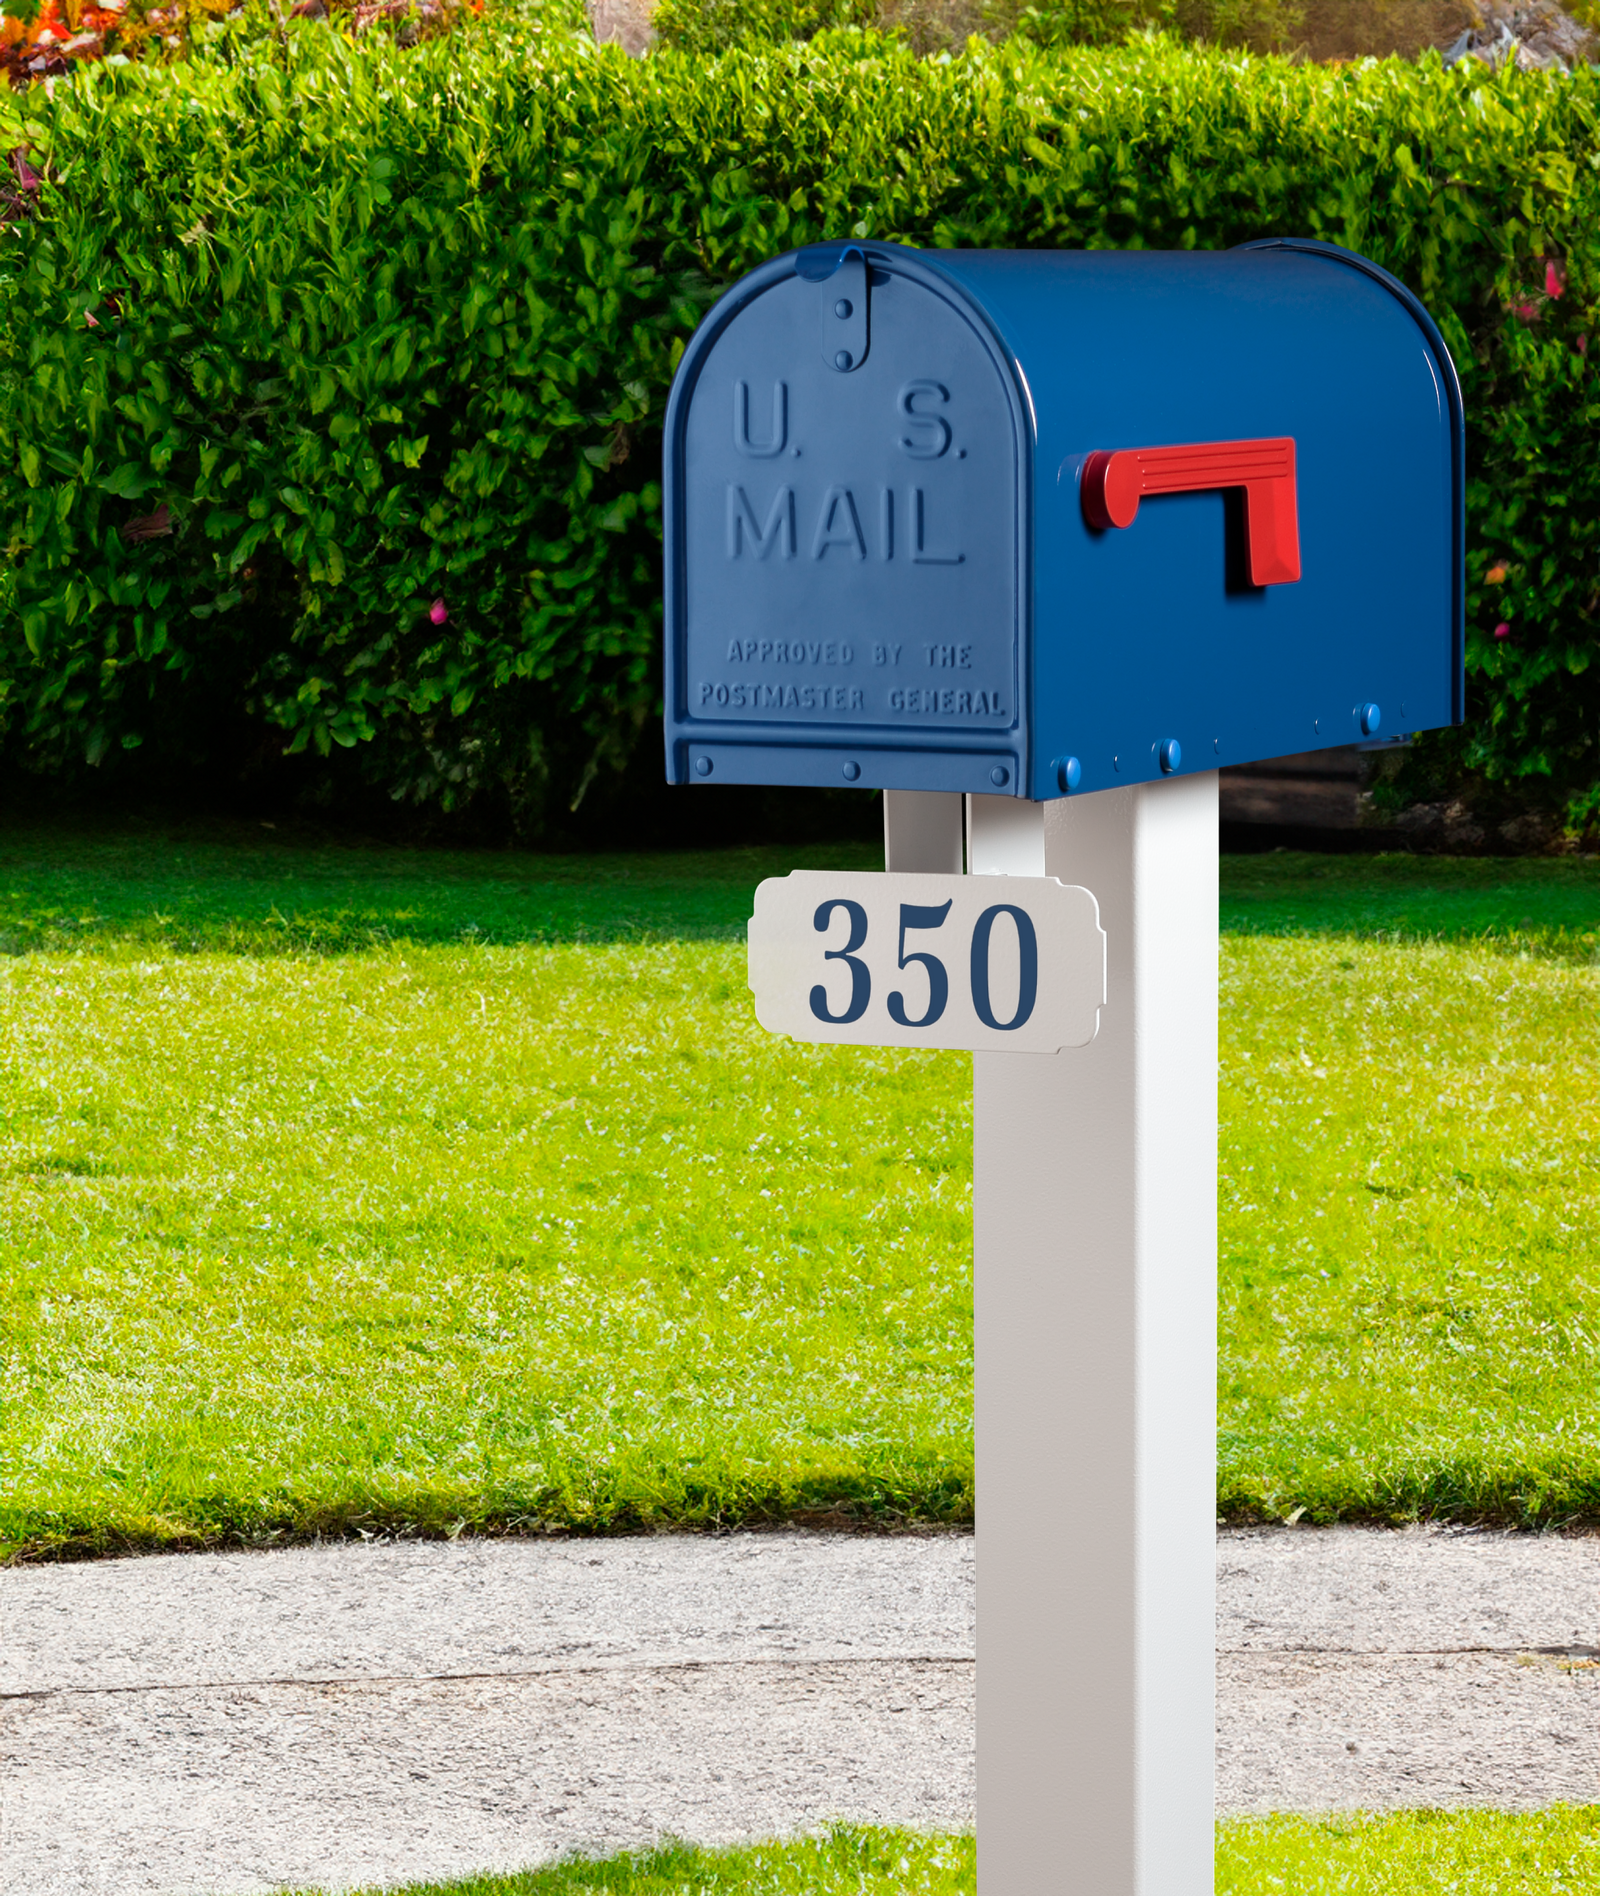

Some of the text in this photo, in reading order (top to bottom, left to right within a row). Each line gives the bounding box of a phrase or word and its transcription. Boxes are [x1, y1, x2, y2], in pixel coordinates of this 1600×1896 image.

[732, 378, 968, 462] U. S.
[725, 482, 966, 565] MAIL
[726, 638, 972, 670] APPROVED BY THE
[699, 682, 1006, 716] POSTMASTER GENERAL
[809, 897, 1038, 1031] 350
